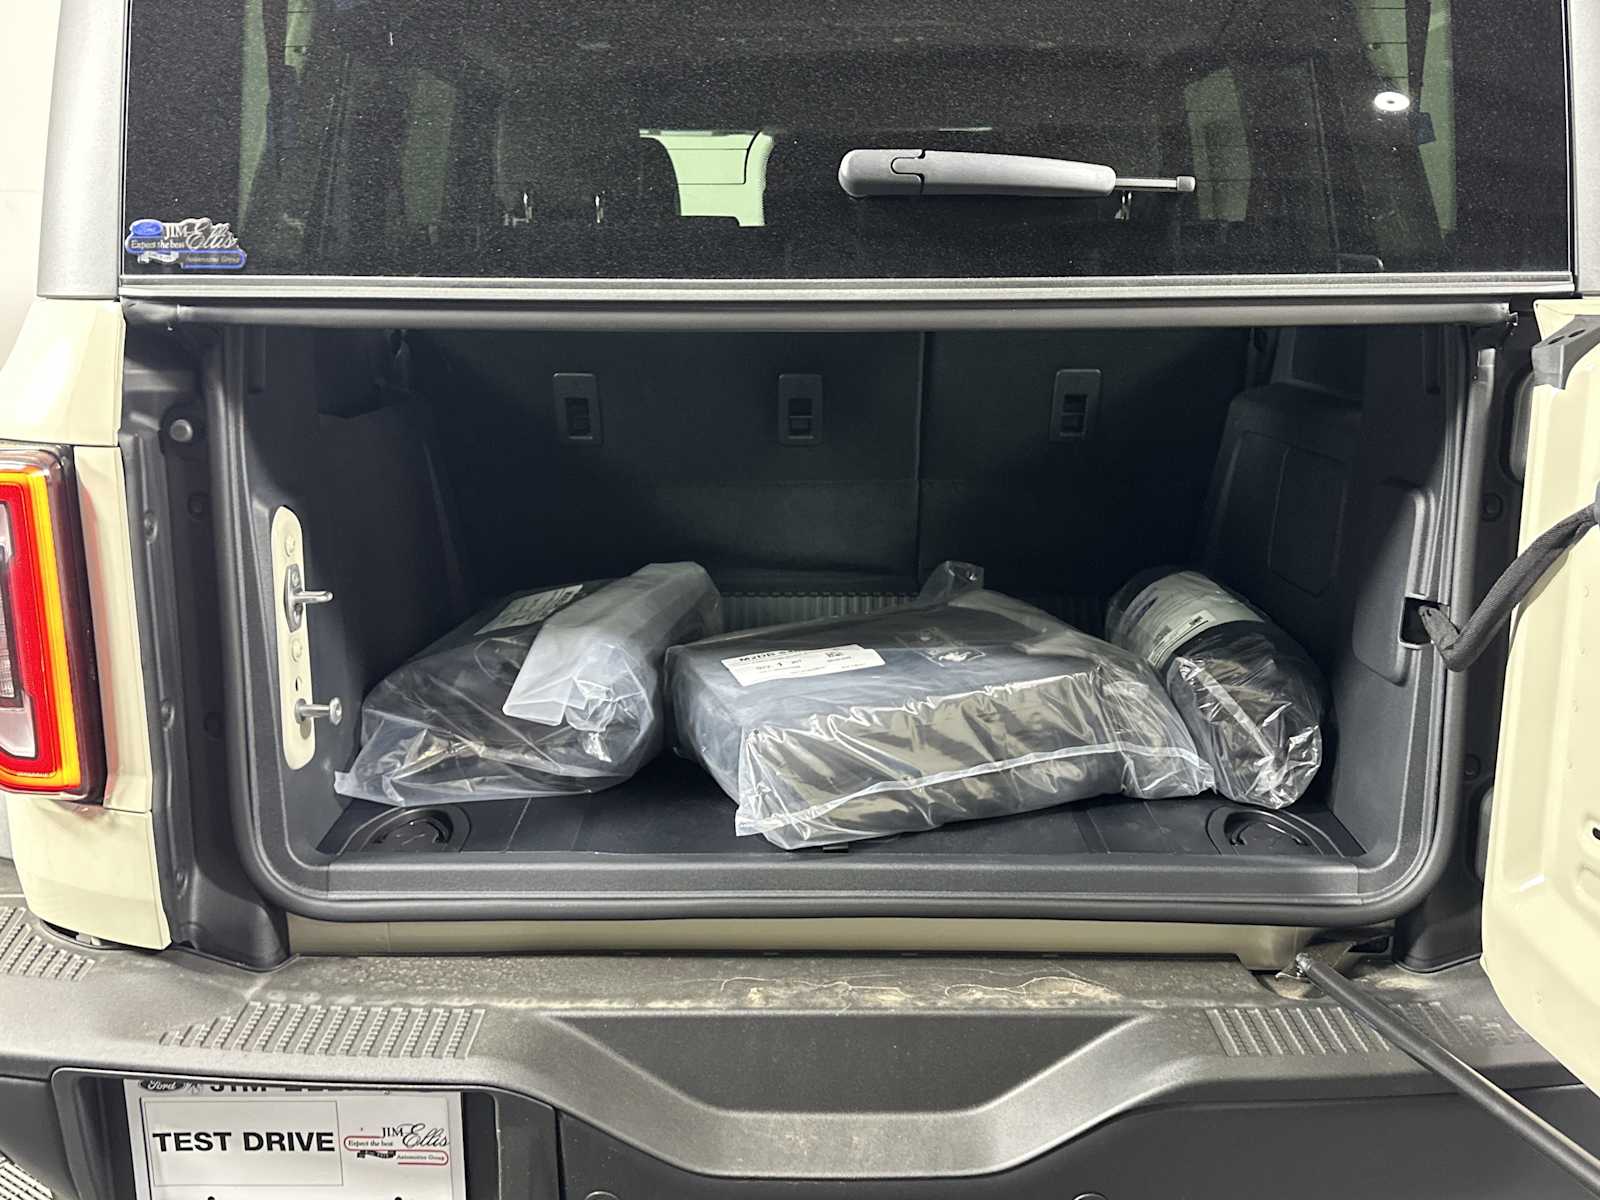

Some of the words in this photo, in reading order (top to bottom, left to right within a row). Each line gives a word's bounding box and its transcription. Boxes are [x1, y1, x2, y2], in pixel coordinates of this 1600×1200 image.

[164, 223, 188, 239] JIM
[187, 218, 240, 250] Ellis
[148, 1079, 177, 1090] Ford
[152, 1131, 232, 1152] TEST
[243, 1131, 335, 1152] DRIVE
[348, 1139, 369, 1147] Expect
[381, 1139, 393, 1147] best
[382, 1127, 404, 1137] JIM
[400, 1123, 449, 1148] Ellis
